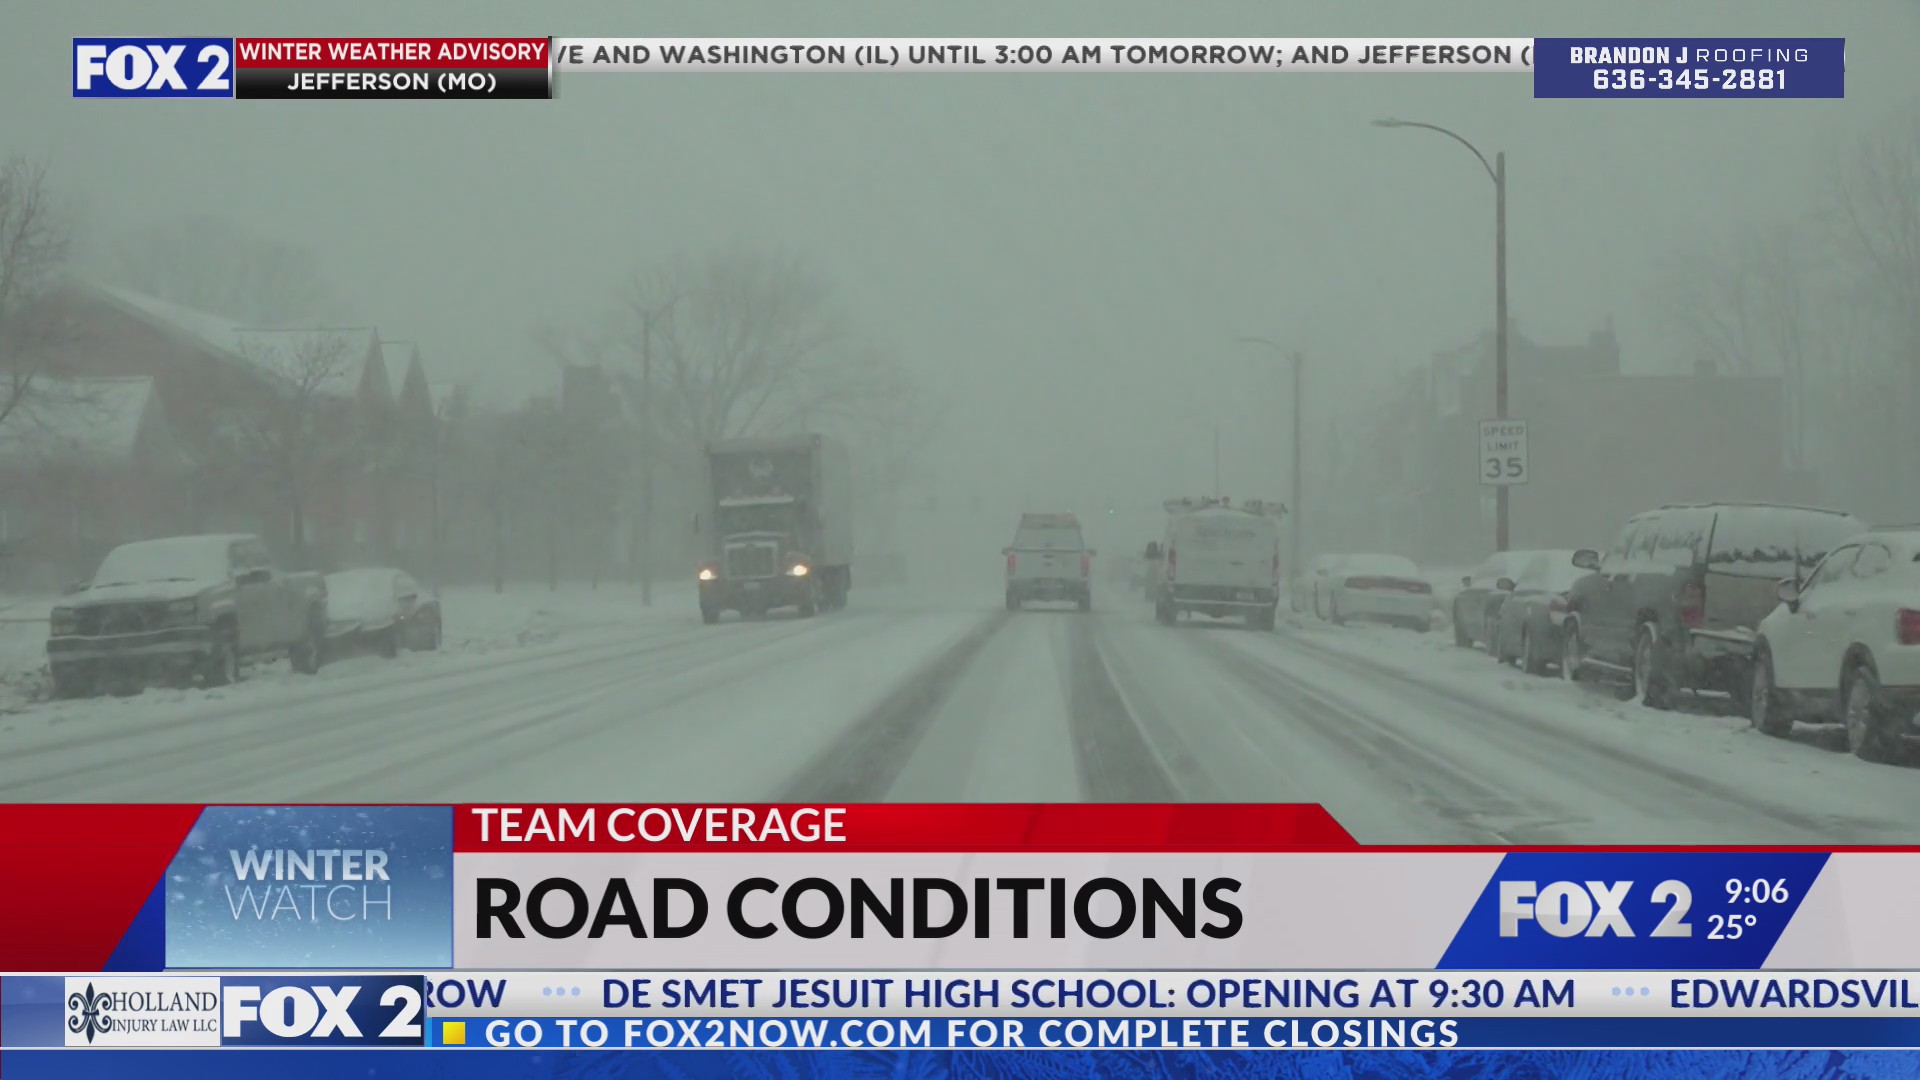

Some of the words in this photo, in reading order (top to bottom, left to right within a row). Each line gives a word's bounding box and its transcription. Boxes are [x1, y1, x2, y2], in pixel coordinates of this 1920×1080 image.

[1483, 426, 1523, 436] SPEED
[1487, 441, 1518, 451] LIMIT
[1486, 457, 1523, 478] 35
